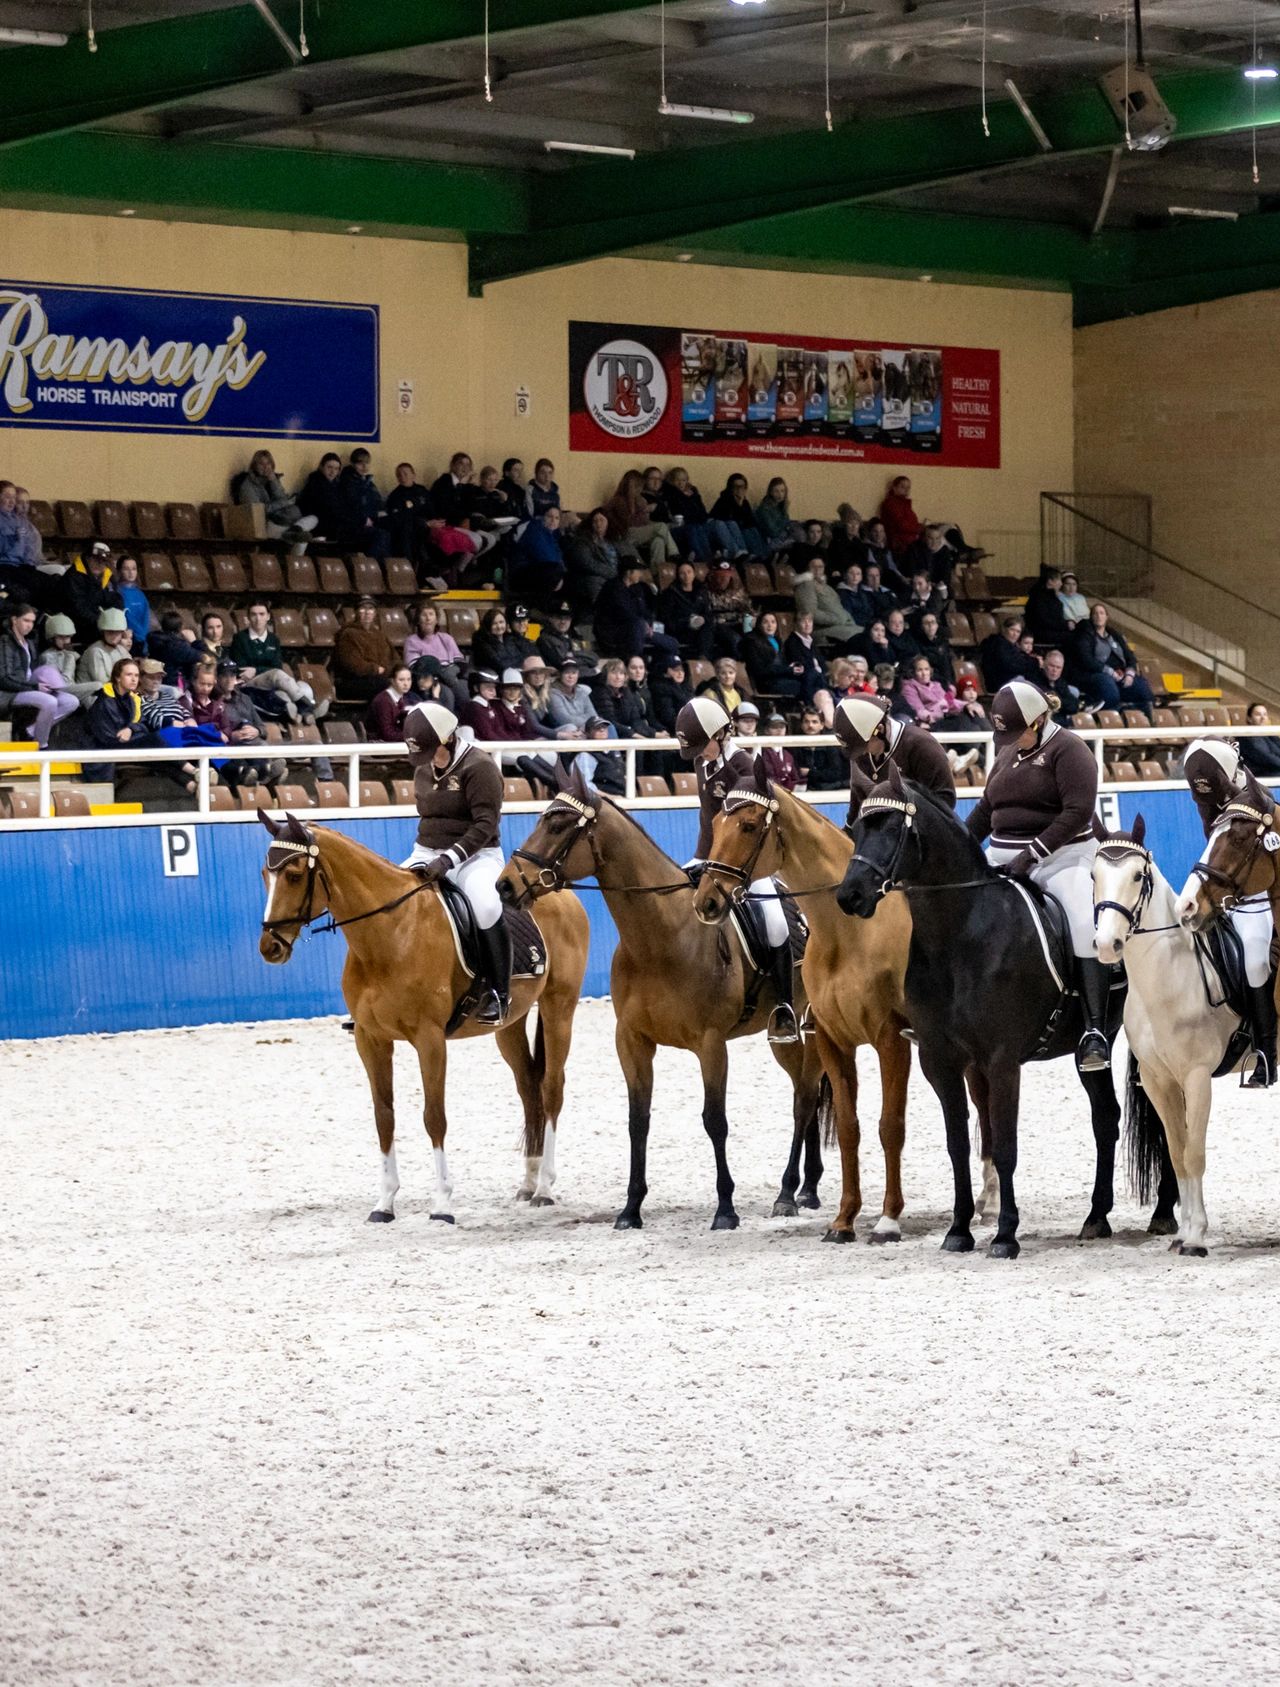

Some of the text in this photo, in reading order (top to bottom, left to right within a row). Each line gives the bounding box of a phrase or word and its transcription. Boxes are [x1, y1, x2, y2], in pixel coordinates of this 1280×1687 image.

[0, 290, 267, 422] Ramsay's
[952, 377, 991, 391] HEALTHY
[37, 386, 178, 408] HORSE TRANSPORT
[951, 401, 991, 416] NATURAL
[958, 425, 986, 439] FRESH
[1099, 796, 1112, 828] F
[167, 829, 190, 872] P
